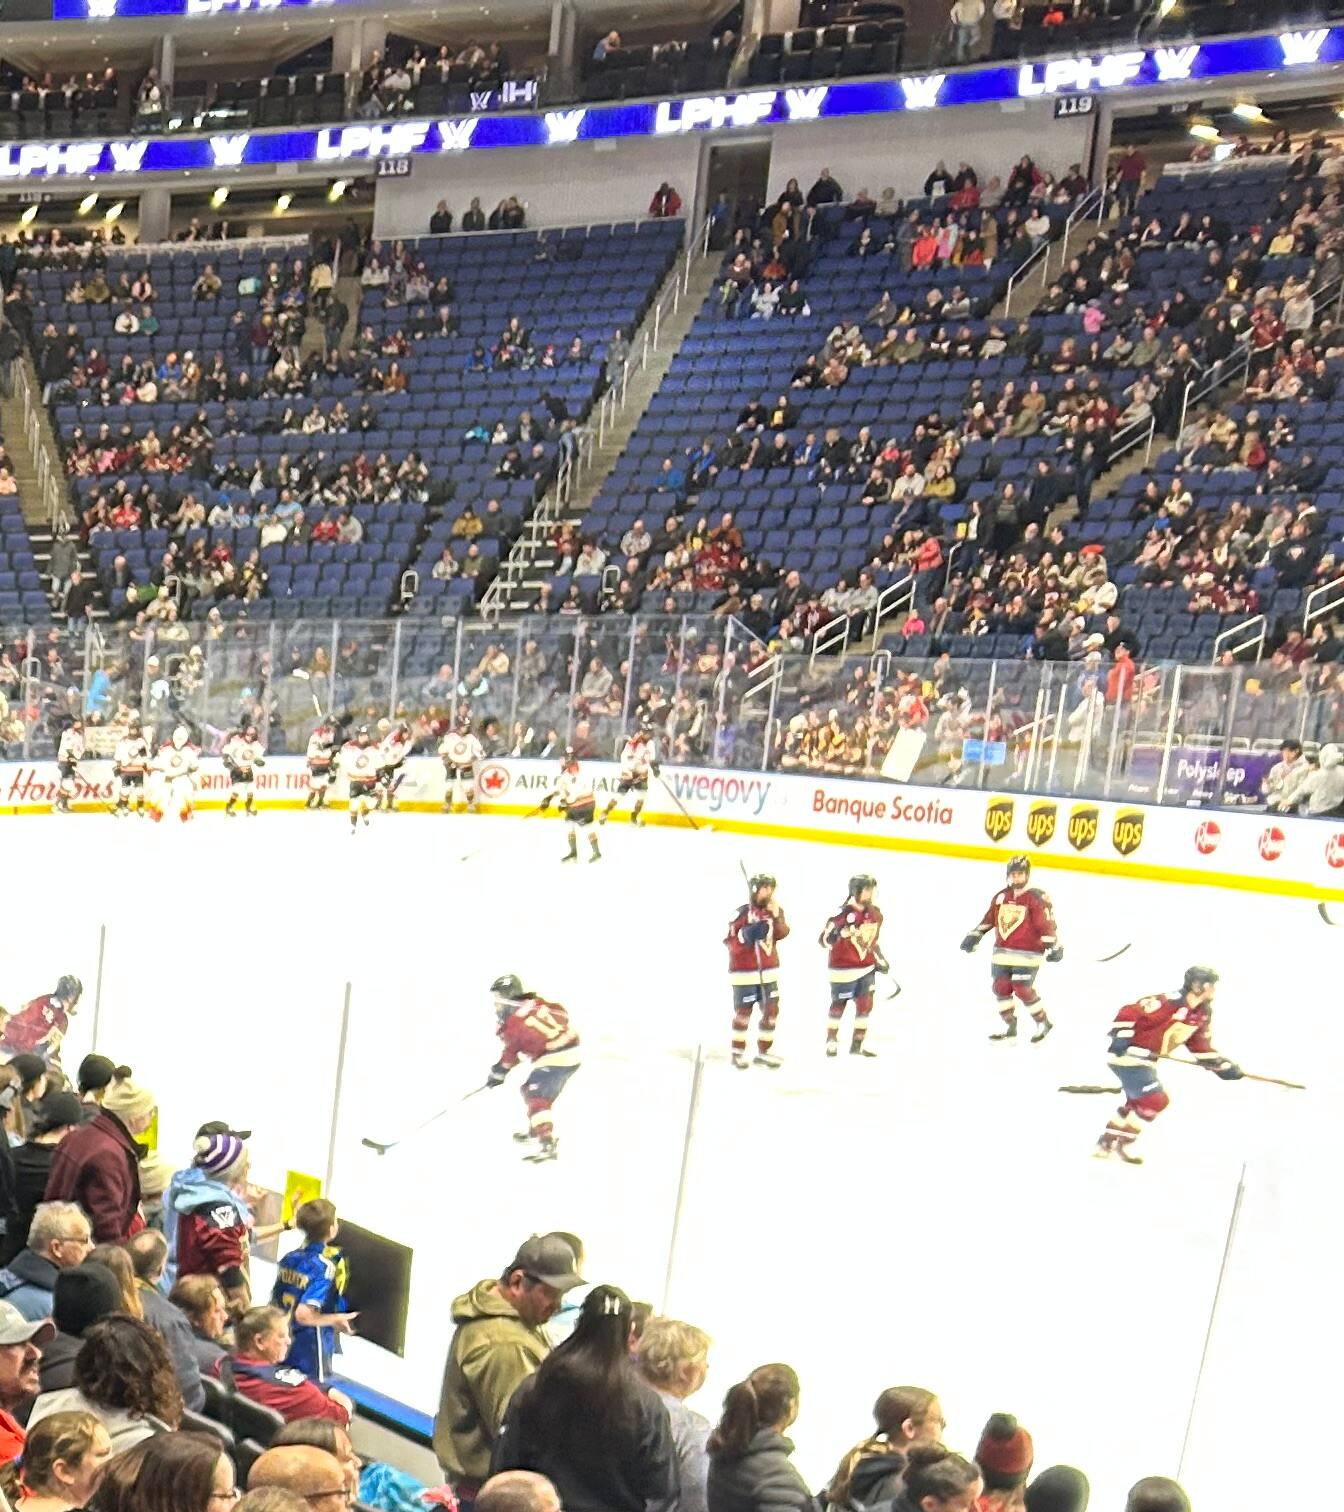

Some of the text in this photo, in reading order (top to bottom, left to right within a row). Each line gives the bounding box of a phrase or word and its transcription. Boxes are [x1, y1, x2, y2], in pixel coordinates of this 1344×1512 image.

[1018, 50, 1146, 98] LPHF
[655, 91, 776, 134] LPHF
[1058, 97, 1093, 116] 119
[316, 119, 431, 160] LPHF
[378, 159, 409, 176] 118
[515, 773, 548, 790] AIR
[1177, 758, 1246, 787] Polyslep
[674, 773, 772, 815] wegovy
[813, 788, 954, 825] Banque Scotia
[986, 810, 1012, 838] ups
[1028, 813, 1055, 843] ups
[1069, 818, 1097, 847] ups
[1114, 822, 1142, 852] ups
